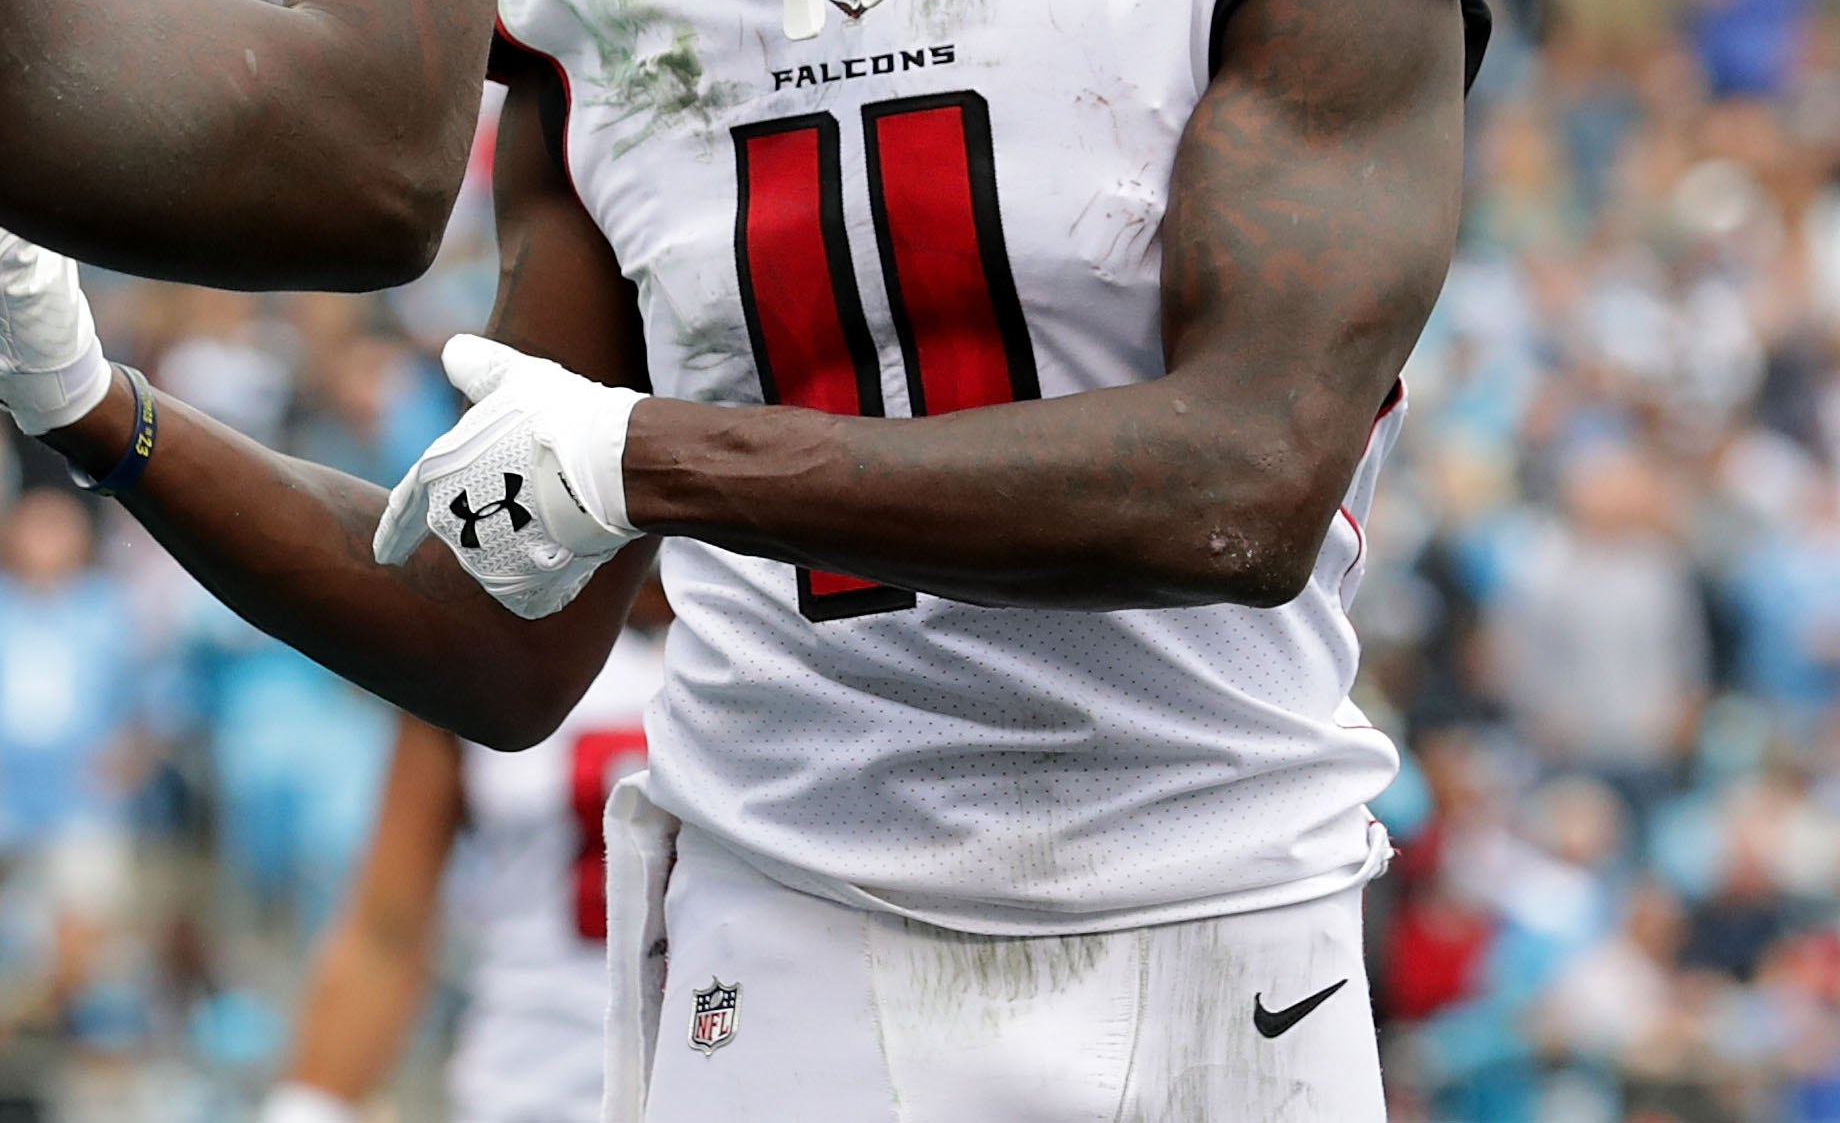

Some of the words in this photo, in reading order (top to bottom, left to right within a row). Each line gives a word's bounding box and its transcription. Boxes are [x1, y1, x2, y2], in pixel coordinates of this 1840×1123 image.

[771, 44, 956, 91] FALCONS
[729, 89, 1043, 623] 11
[695, 1011, 729, 1042] NFL
